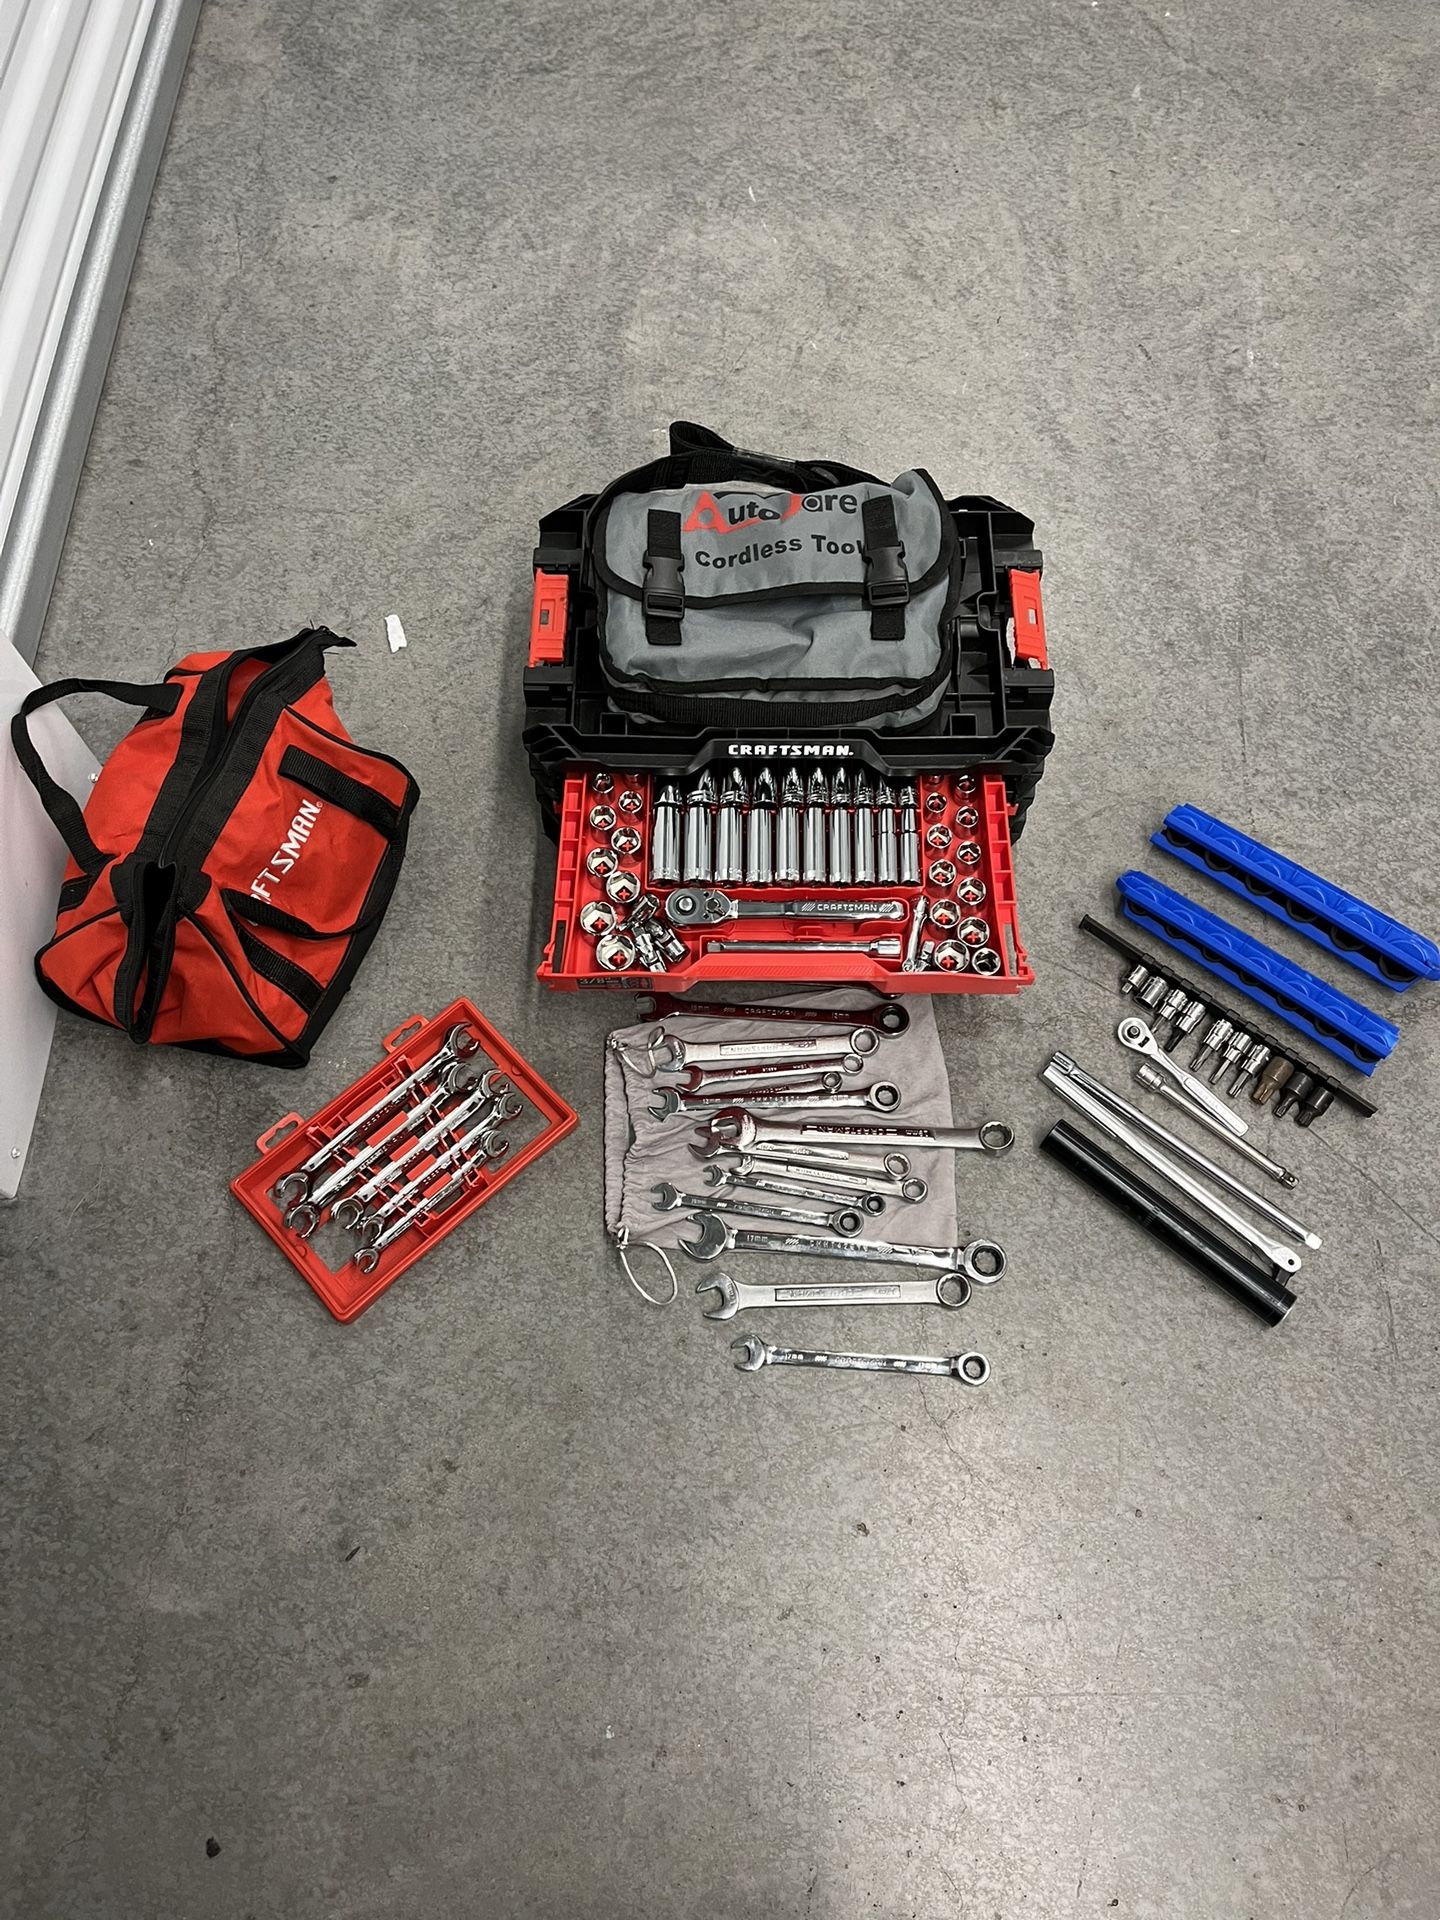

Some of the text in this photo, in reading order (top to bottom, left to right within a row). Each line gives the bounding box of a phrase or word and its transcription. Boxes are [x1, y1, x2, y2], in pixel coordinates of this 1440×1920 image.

[695, 538, 803, 569] Cordless
[728, 744, 850, 756] CRAFTSMAN
[817, 903, 877, 912] CRAFTSMAN
